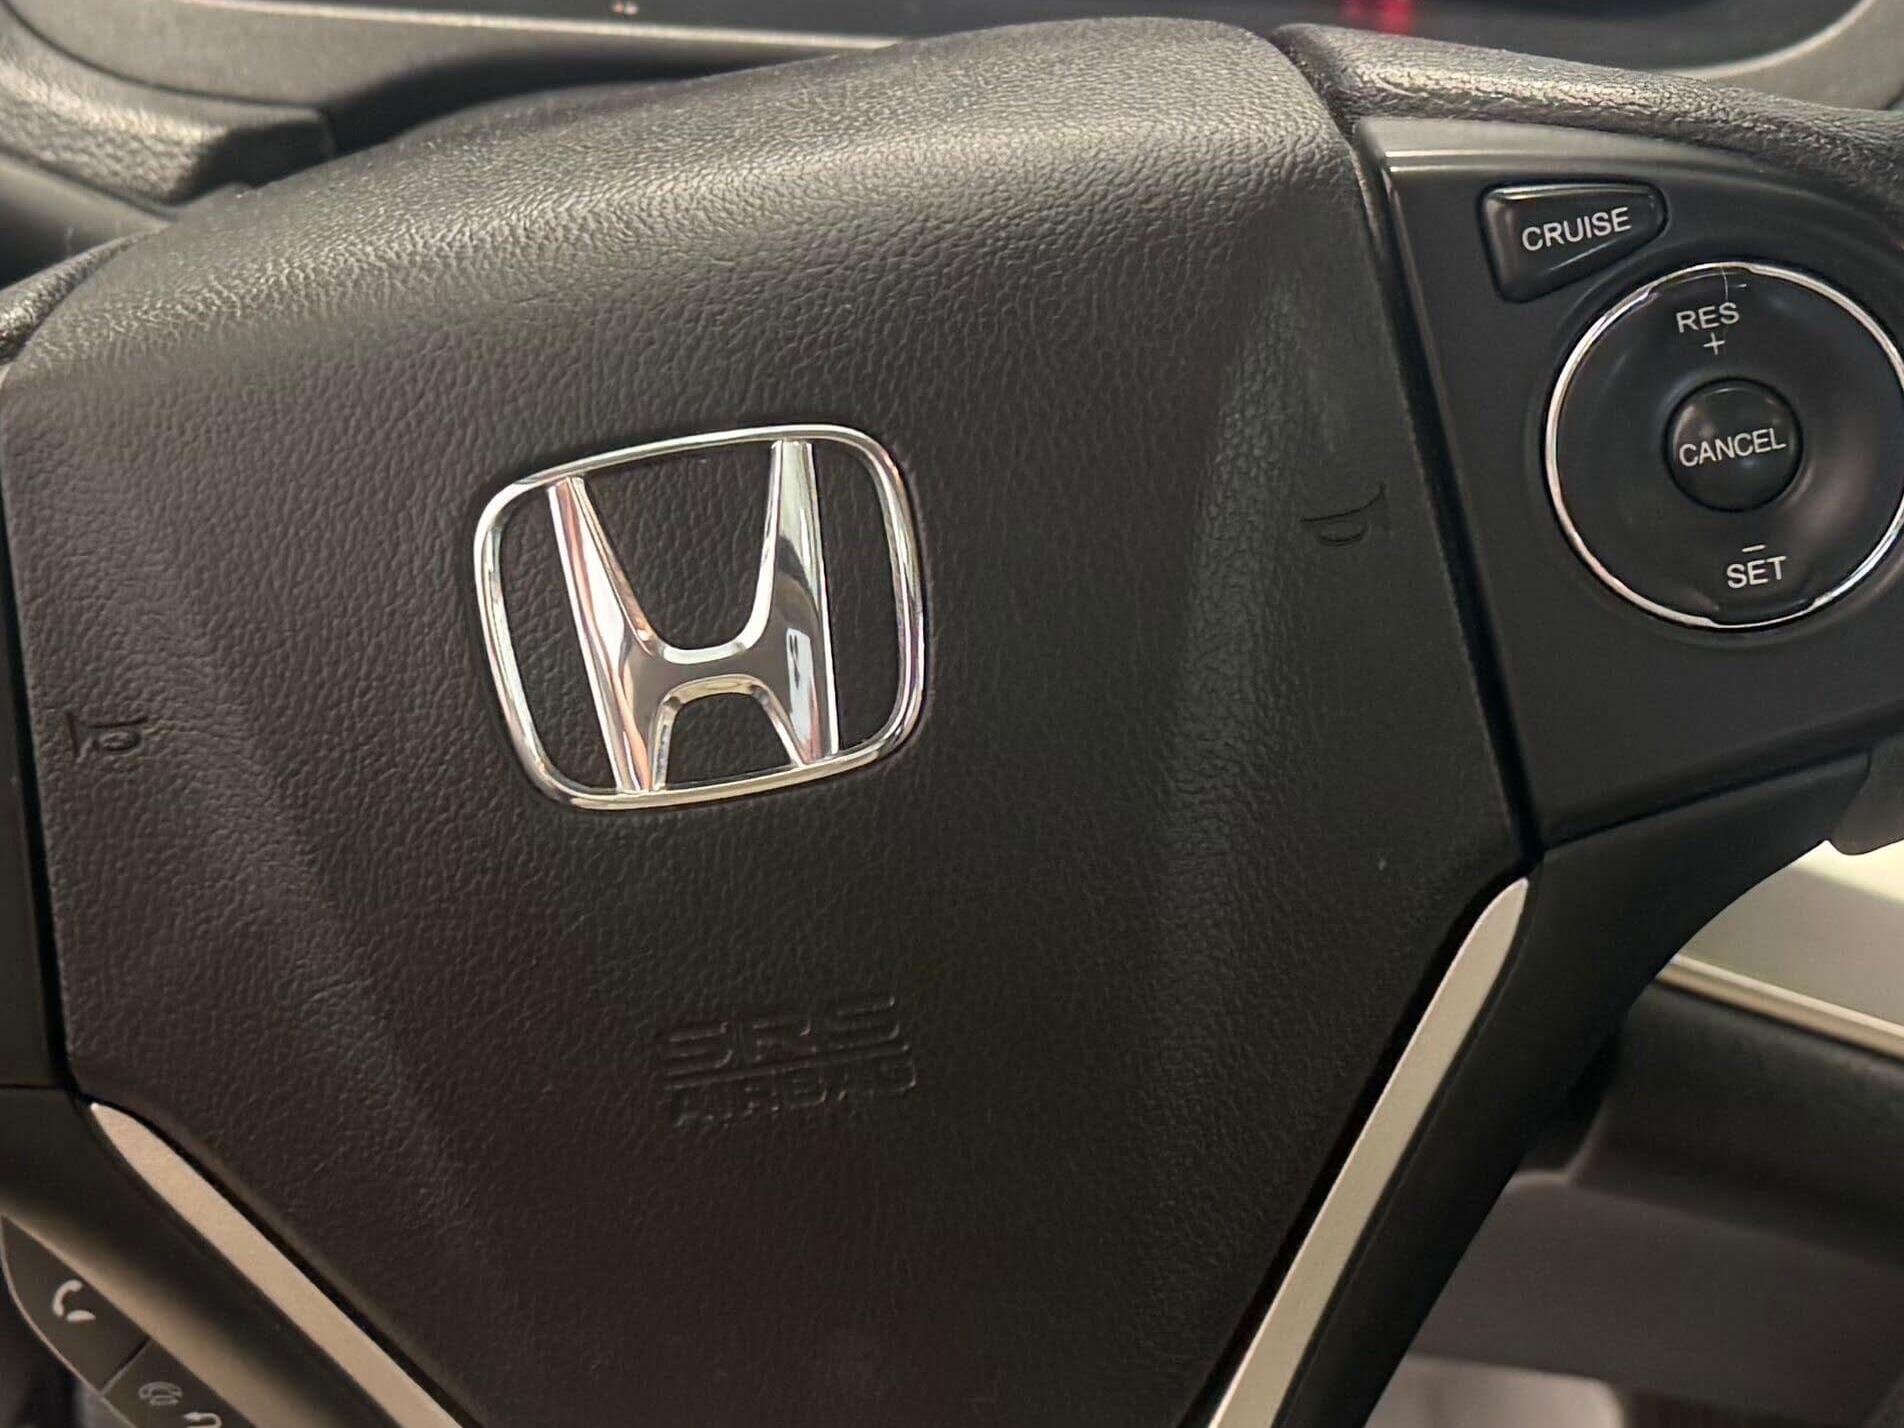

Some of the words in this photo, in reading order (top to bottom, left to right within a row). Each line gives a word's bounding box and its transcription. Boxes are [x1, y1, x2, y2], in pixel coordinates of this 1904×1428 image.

[1520, 206, 1632, 253] CRUISE
[1675, 302, 1741, 334] RES
[1678, 428, 1786, 468] CANCEL
[1726, 555, 1786, 589] SET
